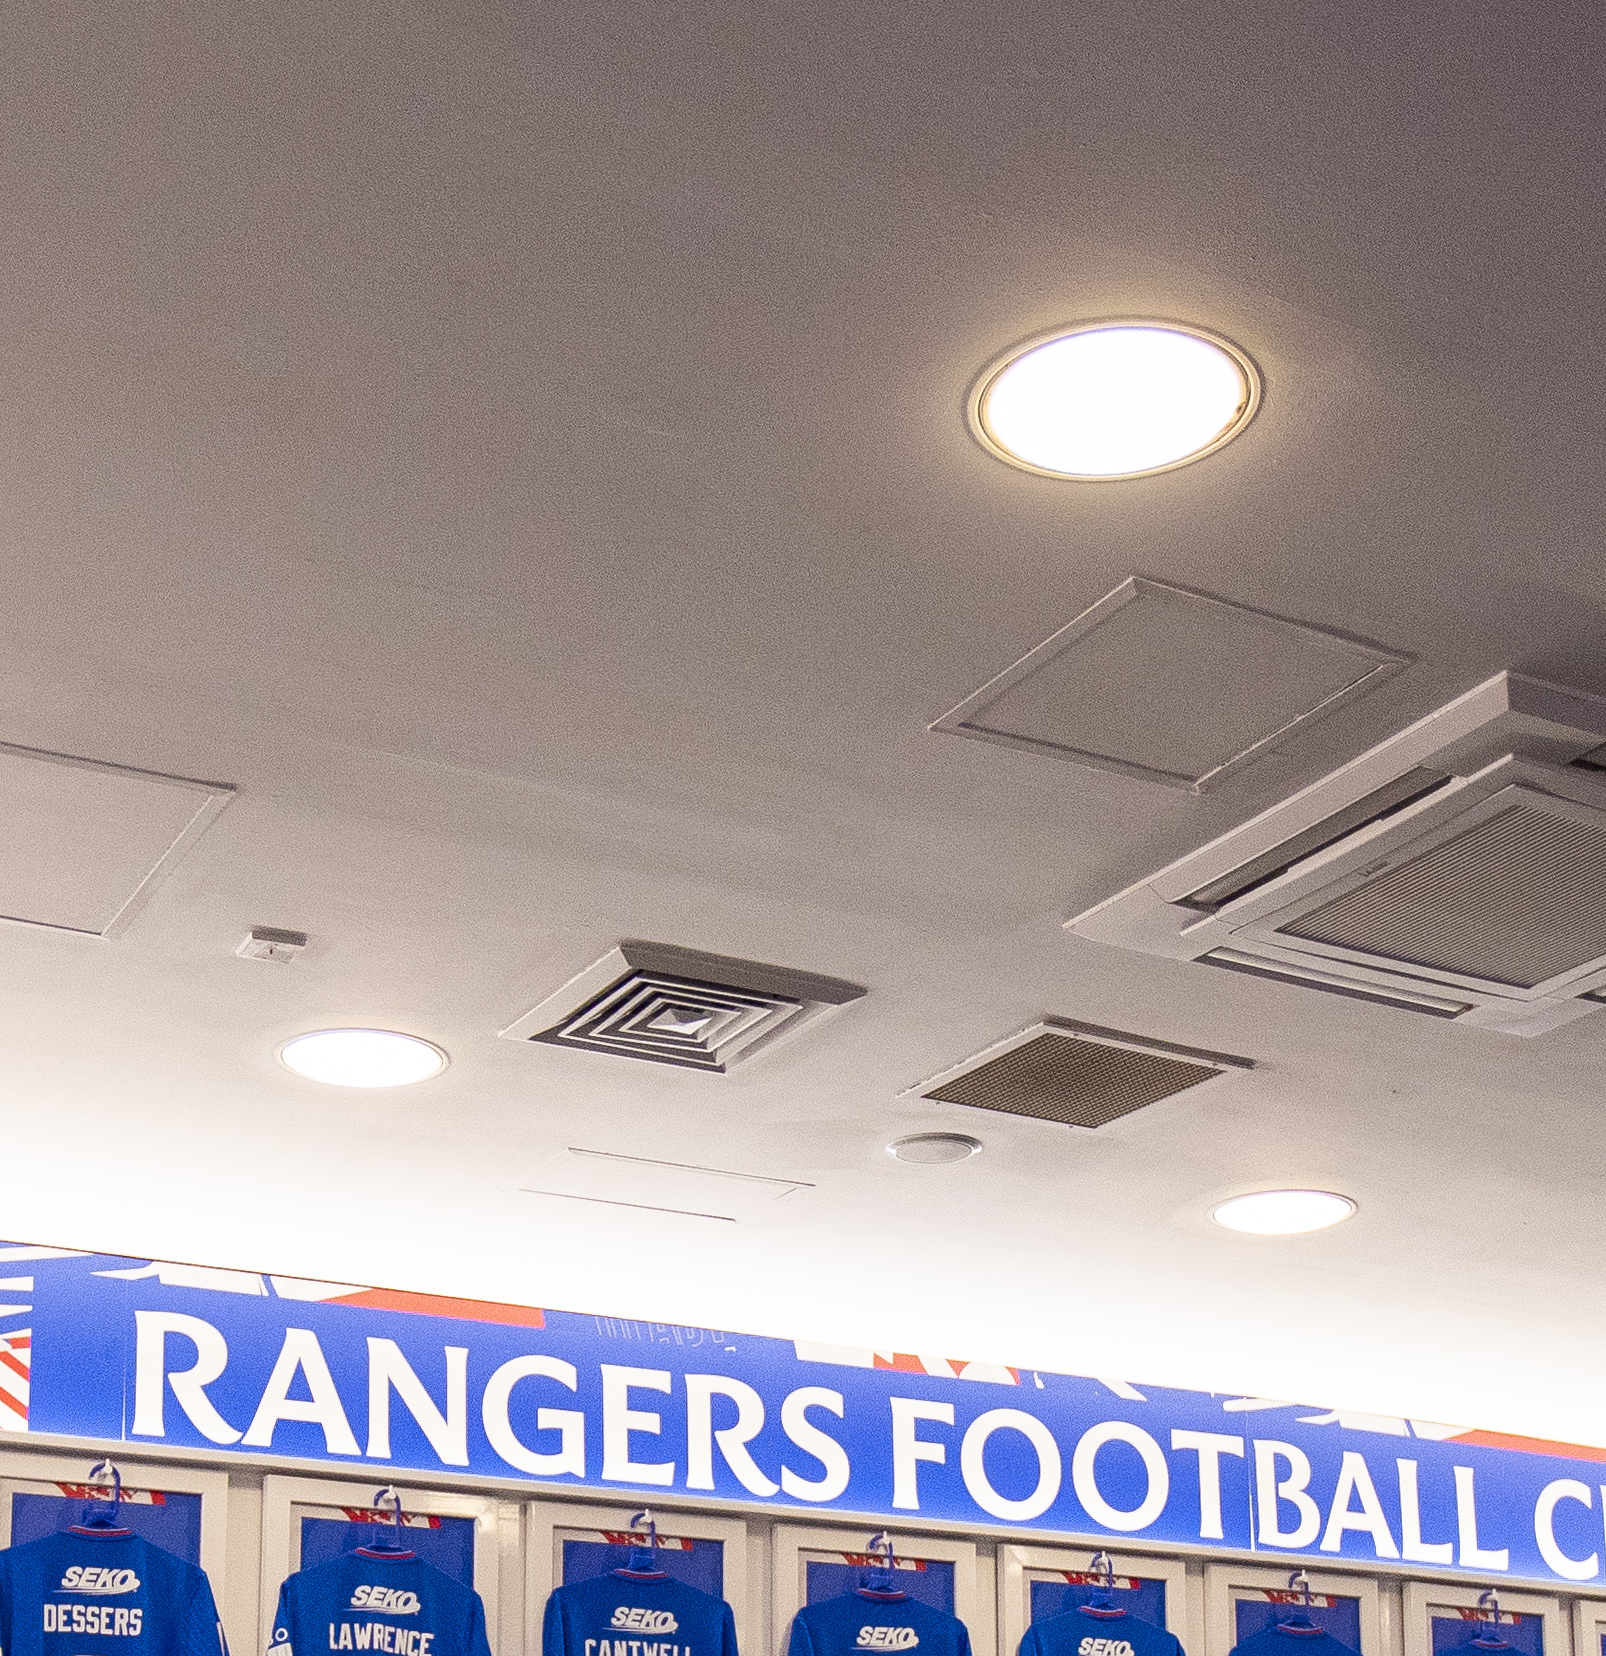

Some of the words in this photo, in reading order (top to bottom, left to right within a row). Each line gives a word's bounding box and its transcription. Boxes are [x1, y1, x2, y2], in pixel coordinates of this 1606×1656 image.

[131, 1310, 851, 1503] RANGERS
[891, 1397, 1509, 1572] FOOTBALL
[61, 1565, 140, 1595] SEKO
[349, 1585, 420, 1615] SEKO
[43, 1603, 143, 1636] DESSERS
[610, 1606, 678, 1635] SEKO
[855, 1626, 919, 1652] SEKO
